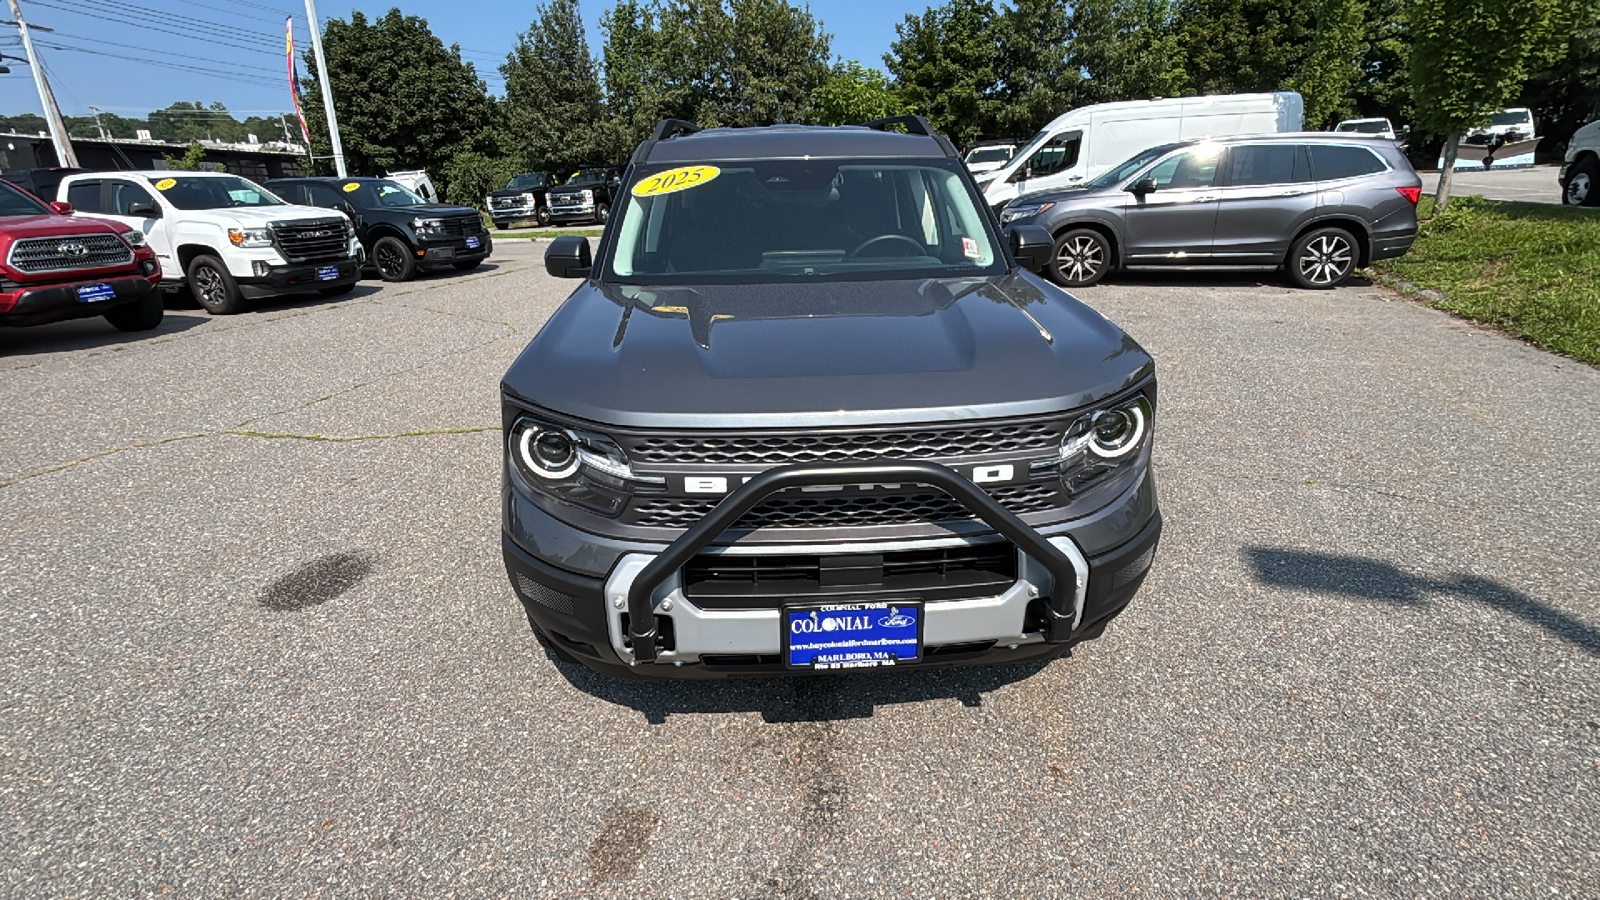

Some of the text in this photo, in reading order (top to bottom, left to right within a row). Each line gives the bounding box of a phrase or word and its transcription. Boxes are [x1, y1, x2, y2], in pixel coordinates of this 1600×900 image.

[647, 168, 705, 193] 2025
[865, 602, 888, 610] FORD
[791, 616, 873, 634] COLONIAL
[790, 638, 917, 651] www.buycolonialfordmarlboro.com
[818, 651, 889, 663] MARLBORO, MA
